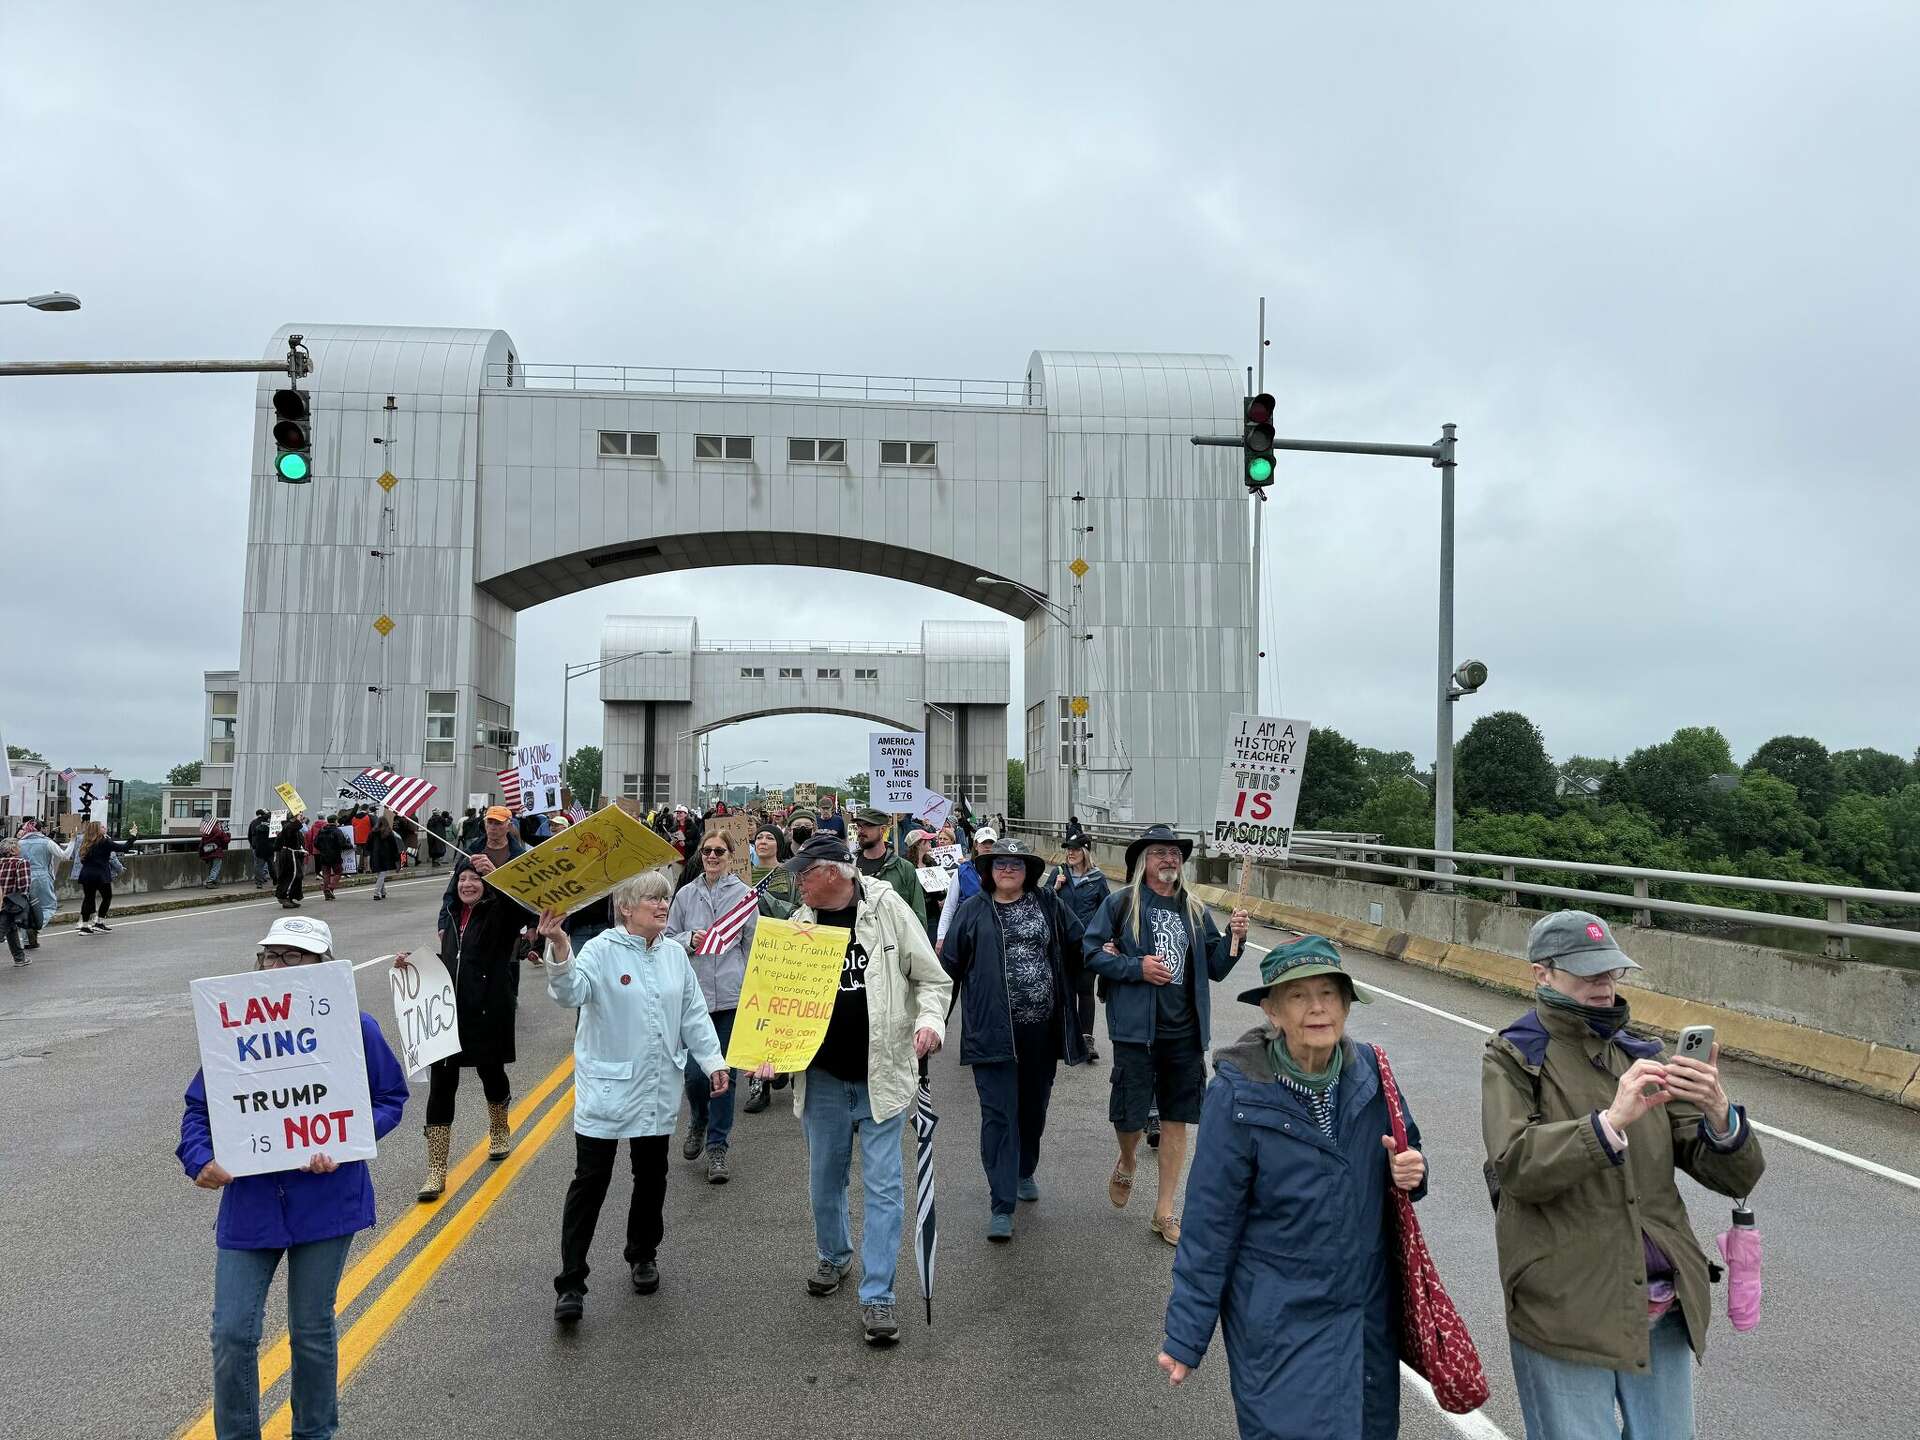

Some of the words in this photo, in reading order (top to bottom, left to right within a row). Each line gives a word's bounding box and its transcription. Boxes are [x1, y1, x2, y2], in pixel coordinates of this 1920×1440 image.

[1241, 720, 1247, 735] I
[1257, 722, 1276, 737] AM
[1283, 724, 1295, 739] A
[877, 737, 915, 746] AMERICA
[881, 747, 912, 756] SAYING
[1234, 736, 1297, 754] HISTORY
[518, 747, 529, 767] NO
[1237, 750, 1290, 765] TEACHER
[874, 769, 886, 778] TO
[894, 769, 919, 778] KINGS
[1235, 771, 1281, 791] THIS
[886, 780, 912, 788] SINCE
[888, 792, 913, 800] 1776
[1234, 791, 1272, 820] IS
[511, 852, 544, 873] THE
[511, 857, 577, 894] LYING
[531, 879, 586, 909] KING
[782, 956, 802, 967] have
[392, 961, 420, 1001] NO
[752, 965, 759, 975] A
[764, 969, 807, 982] republic
[827, 976, 833, 984] a
[217, 993, 292, 1029] LAW
[309, 995, 331, 1016] is
[744, 993, 760, 1011] A
[767, 996, 834, 1020] REPUBLIC
[756, 1018, 771, 1031] IF
[774, 1026, 794, 1036] we
[797, 1029, 817, 1037] can
[236, 1027, 318, 1062] KING
[233, 1083, 328, 1114] TRUMP
[251, 1133, 271, 1154] is
[283, 1109, 354, 1150] NOT
